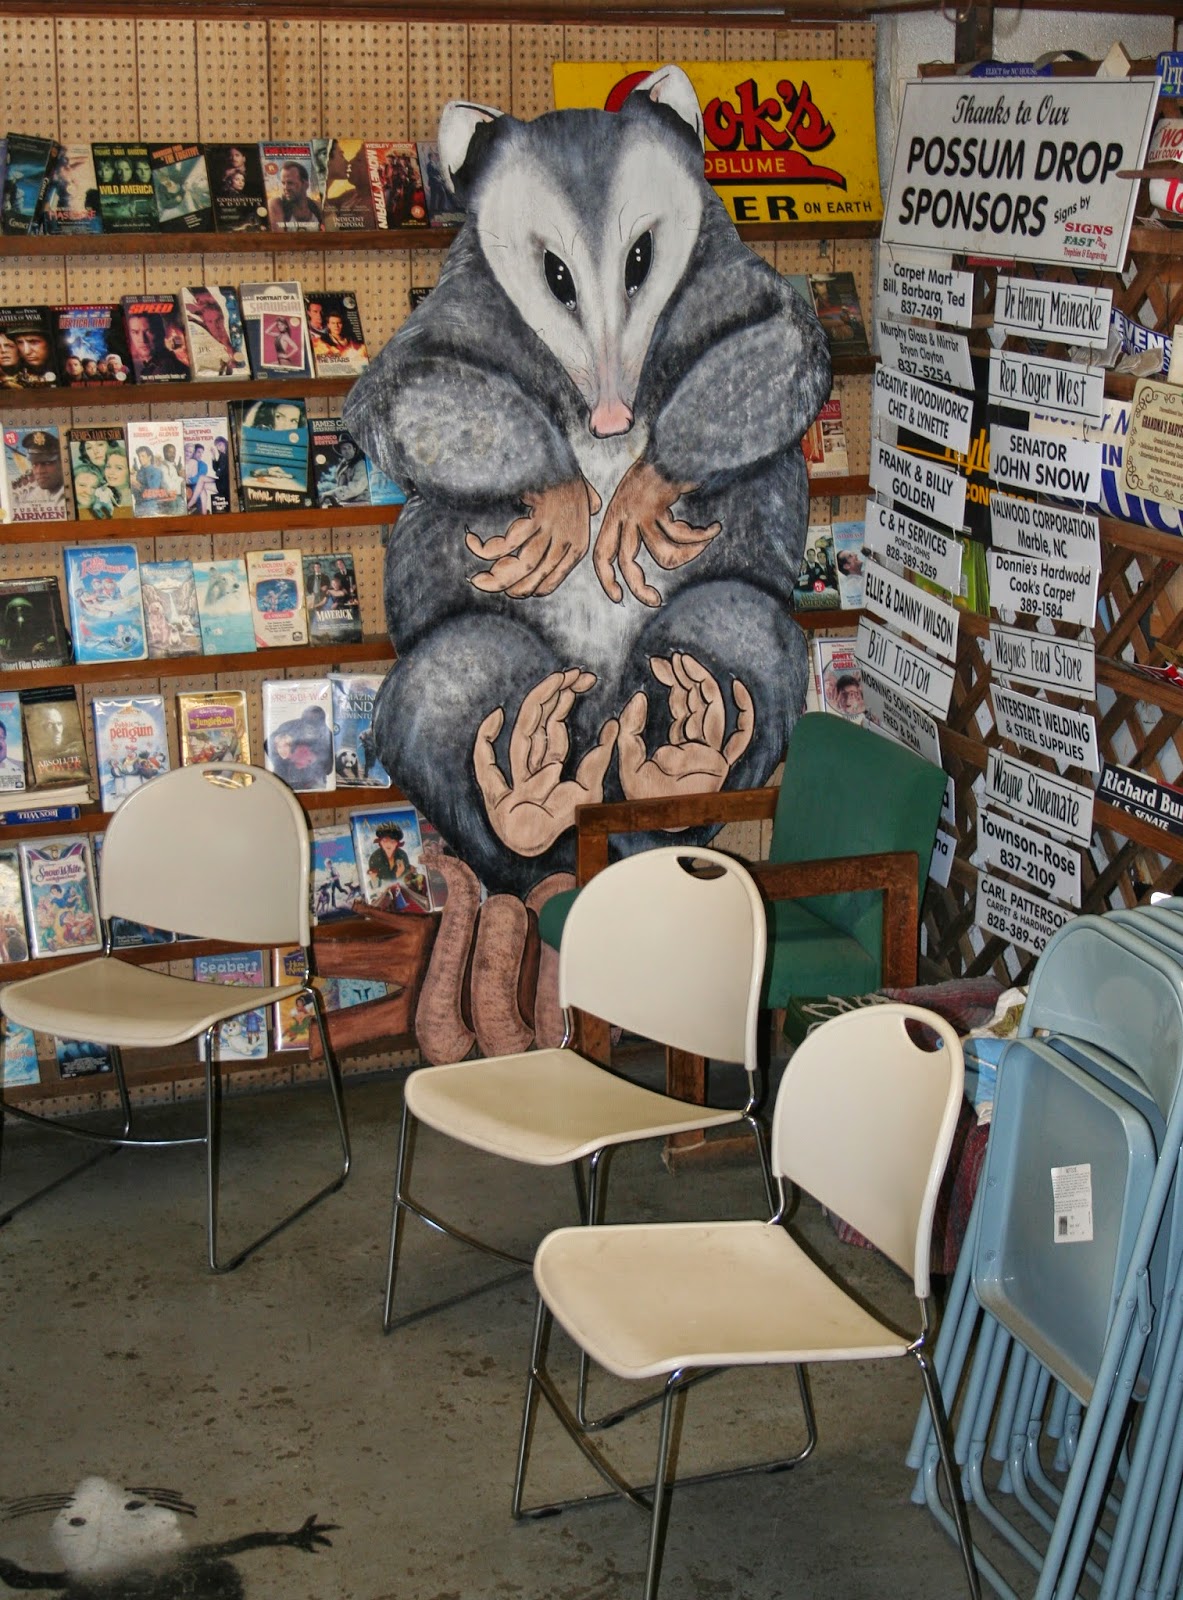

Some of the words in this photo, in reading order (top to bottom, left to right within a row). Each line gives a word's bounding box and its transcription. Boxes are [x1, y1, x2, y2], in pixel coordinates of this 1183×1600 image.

[952, 94, 1010, 125] Thanks
[1014, 102, 1031, 126] to
[1036, 95, 1071, 127] Our
[366, 148, 383, 190] MONEY
[906, 135, 1026, 180] POSSUM
[1033, 140, 1124, 185] DROP
[99, 183, 120, 195] WILD
[120, 183, 154, 195] AMERICA
[373, 190, 388, 230] TRAIN
[803, 202, 822, 214] ON
[828, 201, 873, 215] EARTH
[898, 186, 1049, 238] SPONSORS
[1054, 203, 1077, 224] Signs
[1080, 195, 1091, 211] by
[1062, 235, 1095, 248] FAST
[1064, 221, 1114, 236] SIGNS
[894, 262, 925, 281] Carpet
[928, 268, 953, 287] Mart
[128, 302, 175, 315] SPEED
[883, 278, 899, 297] Bill,
[901, 282, 944, 306] Barbara,
[947, 290, 966, 308] Ted
[25, 313, 42, 321] WAR
[901, 299, 943, 322] 837-7491
[1017, 287, 1046, 331] Henry
[1050, 290, 1103, 332] Meinecke
[880, 321, 907, 344] Murphy
[908, 327, 928, 345] Glass
[929, 332, 935, 347] &
[936, 334, 959, 353] Mirror
[899, 342, 919, 359] Bryan
[919, 346, 945, 365] Clayton
[898, 358, 952, 384] 837-5254
[1000, 358, 1018, 402] Rep.
[1022, 362, 1051, 406] Roger
[1055, 370, 1088, 408] West
[875, 369, 908, 399] CREATIVE
[910, 383, 969, 424] WOODWORKZ
[312, 420, 336, 428] JAMES
[888, 398, 908, 421] CHET
[908, 407, 915, 425] &
[917, 410, 949, 440] LYNETTE
[1009, 433, 1067, 463] SENATOR
[879, 447, 911, 477] FRANK
[914, 463, 923, 484] &
[926, 469, 954, 497] BILLY
[993, 453, 1031, 482] JOHN
[1035, 462, 1090, 495] SNOW
[892, 481, 936, 514] GOLDEN
[13, 511, 66, 521] AIRMEN
[990, 496, 1031, 528] VALWOOD
[1033, 507, 1097, 542] CORPORATION
[879, 509, 887, 527] C
[888, 513, 895, 531] &
[898, 517, 905, 536] H
[908, 522, 947, 557] SERVICES
[1017, 531, 1050, 557] Marble,
[1053, 540, 1068, 559] NC
[886, 543, 938, 581] 828-389-3259
[996, 555, 1038, 578] Donnie's
[1041, 561, 1091, 586] Hardwood
[1009, 576, 1041, 598] Cook's
[1043, 582, 1076, 605] Carpet
[316, 608, 354, 621] MAVERICK
[865, 572, 885, 605] ELLIE
[885, 584, 892, 609] &
[893, 587, 922, 626] DANNY
[923, 604, 954, 648] WILSON
[1019, 596, 1064, 620] 389-1584
[1, 661, 19, 671] Short
[19, 660, 32, 670] Film
[867, 627, 888, 668] Bill
[892, 641, 931, 696] Tipton
[993, 631, 1026, 673] Wayne's
[1029, 640, 1051, 675] Feed
[1054, 649, 1083, 683] Store
[883, 710, 899, 732] FRED
[900, 724, 906, 738] &
[906, 729, 921, 751] PAM
[893, 693, 912, 719] SONG
[912, 709, 936, 740] STUDIO
[995, 692, 1043, 732] INTERSTATE
[1045, 711, 1091, 744] WELDING
[1006, 719, 1013, 734] &
[1014, 723, 1037, 746] STEEL
[1039, 735, 1085, 762] SUPPLIES
[37, 755, 81, 769] ABSOLUTE
[992, 758, 1023, 804] Wayne
[1026, 772, 1080, 828] Shoemate
[1102, 768, 1158, 809] Richard
[1134, 809, 1170, 832] SENATE
[980, 813, 1076, 877] Townson-Rose
[36, 865, 59, 882] Snow
[60, 864, 81, 874] White
[999, 849, 1057, 890] 837-2109
[981, 879, 1007, 903] CARL
[986, 898, 1011, 917] CARPET
[1013, 910, 1018, 920] &
[199, 961, 258, 974] Seabert
